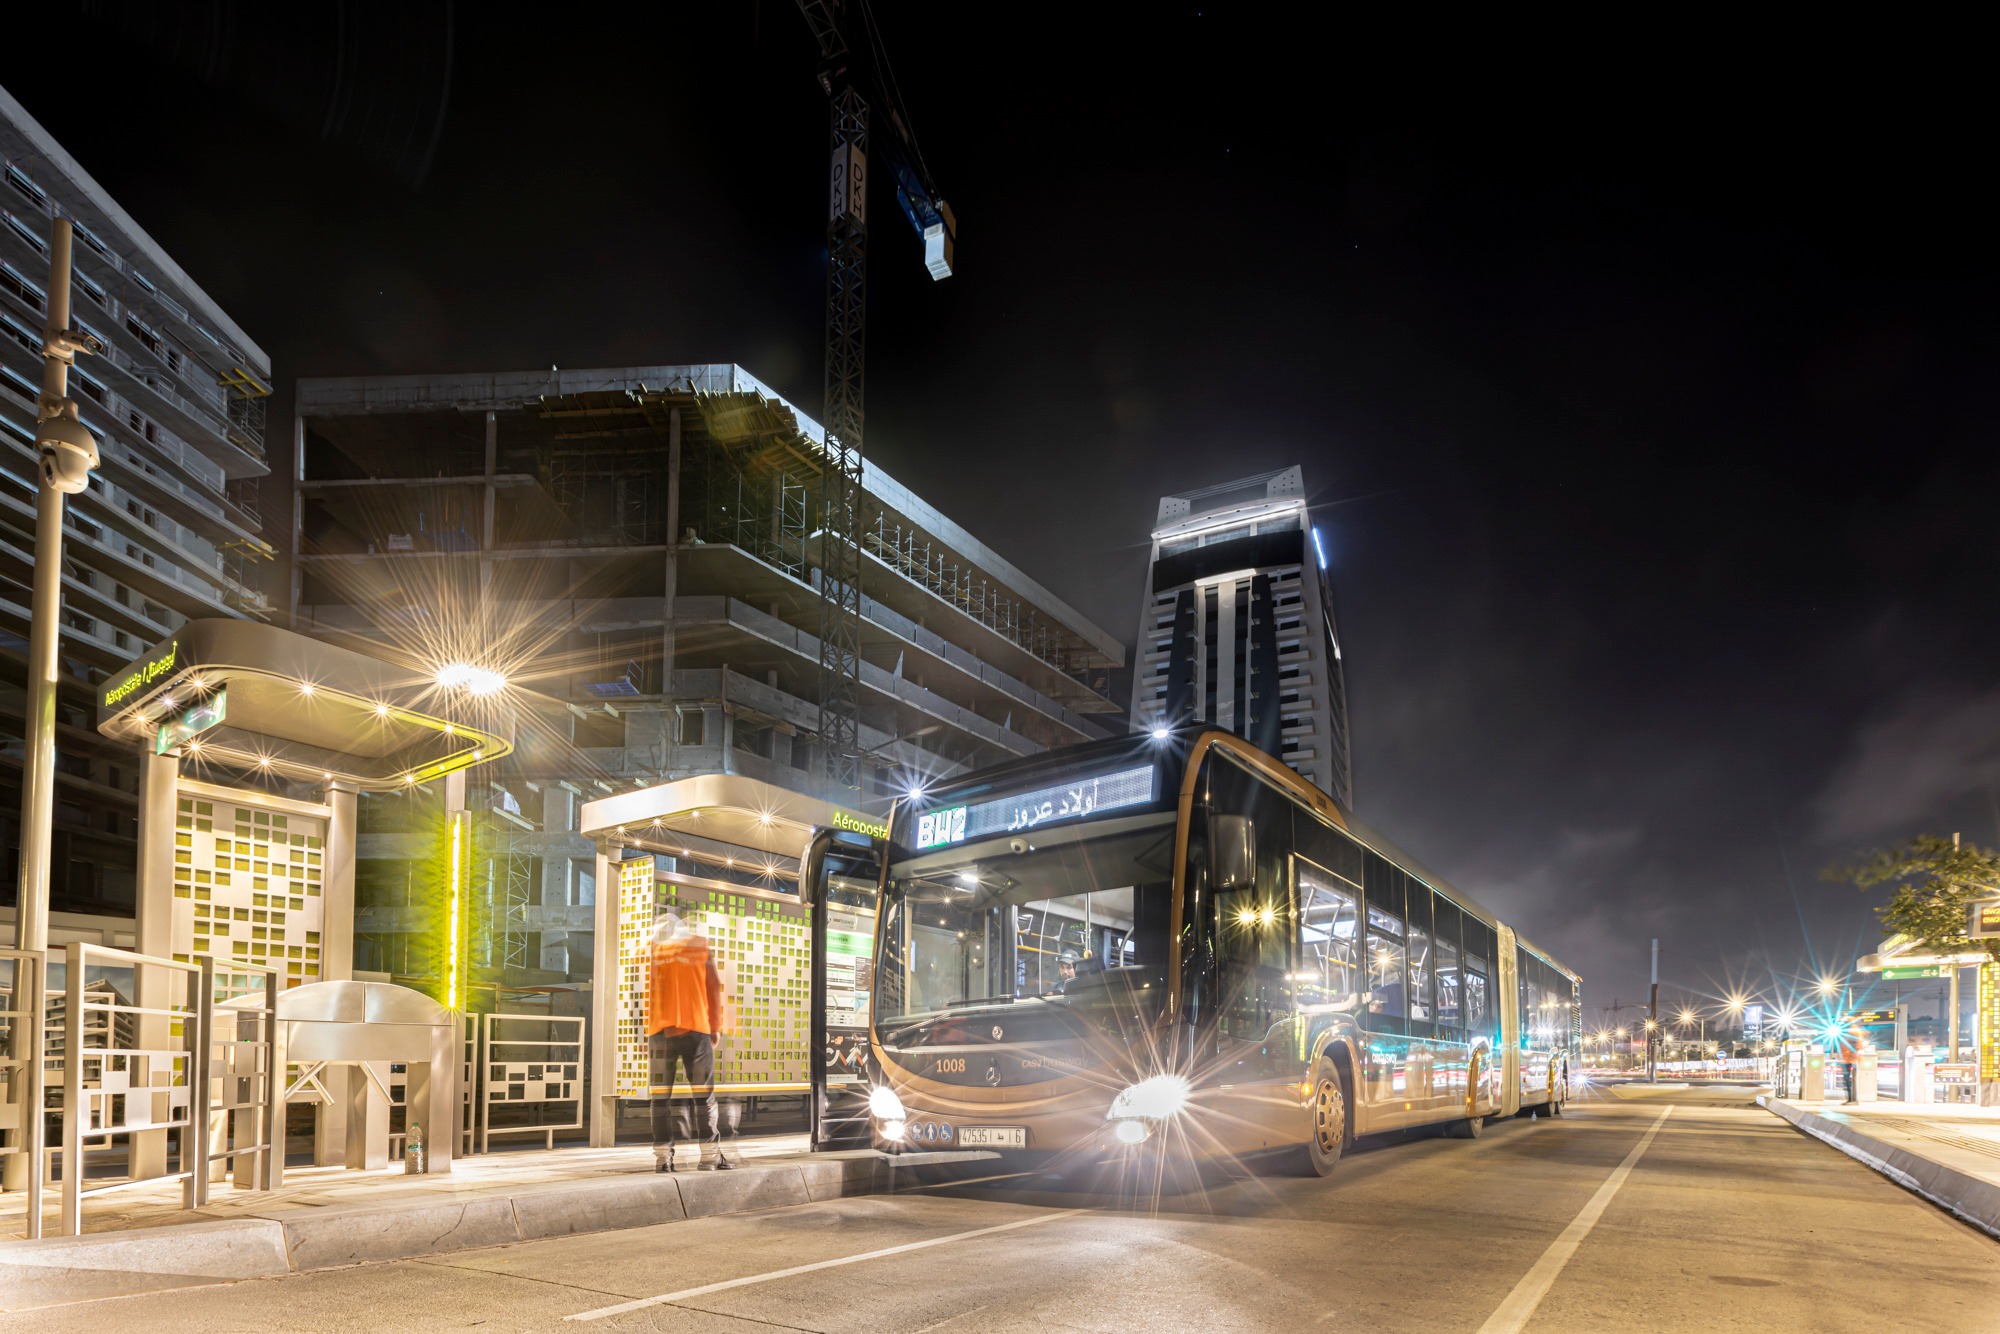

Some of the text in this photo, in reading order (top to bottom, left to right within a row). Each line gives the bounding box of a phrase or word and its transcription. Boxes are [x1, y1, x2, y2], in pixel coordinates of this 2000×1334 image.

[833, 164, 843, 216] DKH
[854, 162, 863, 219] DKH
[1059, 778, 1100, 816] أولاد
[832, 811, 889, 839] Aéroposta
[917, 805, 967, 849] BW2
[936, 1058, 966, 1073] 1008
[962, 1129, 987, 1144] 47535
[1015, 1129, 1021, 1143] 6
